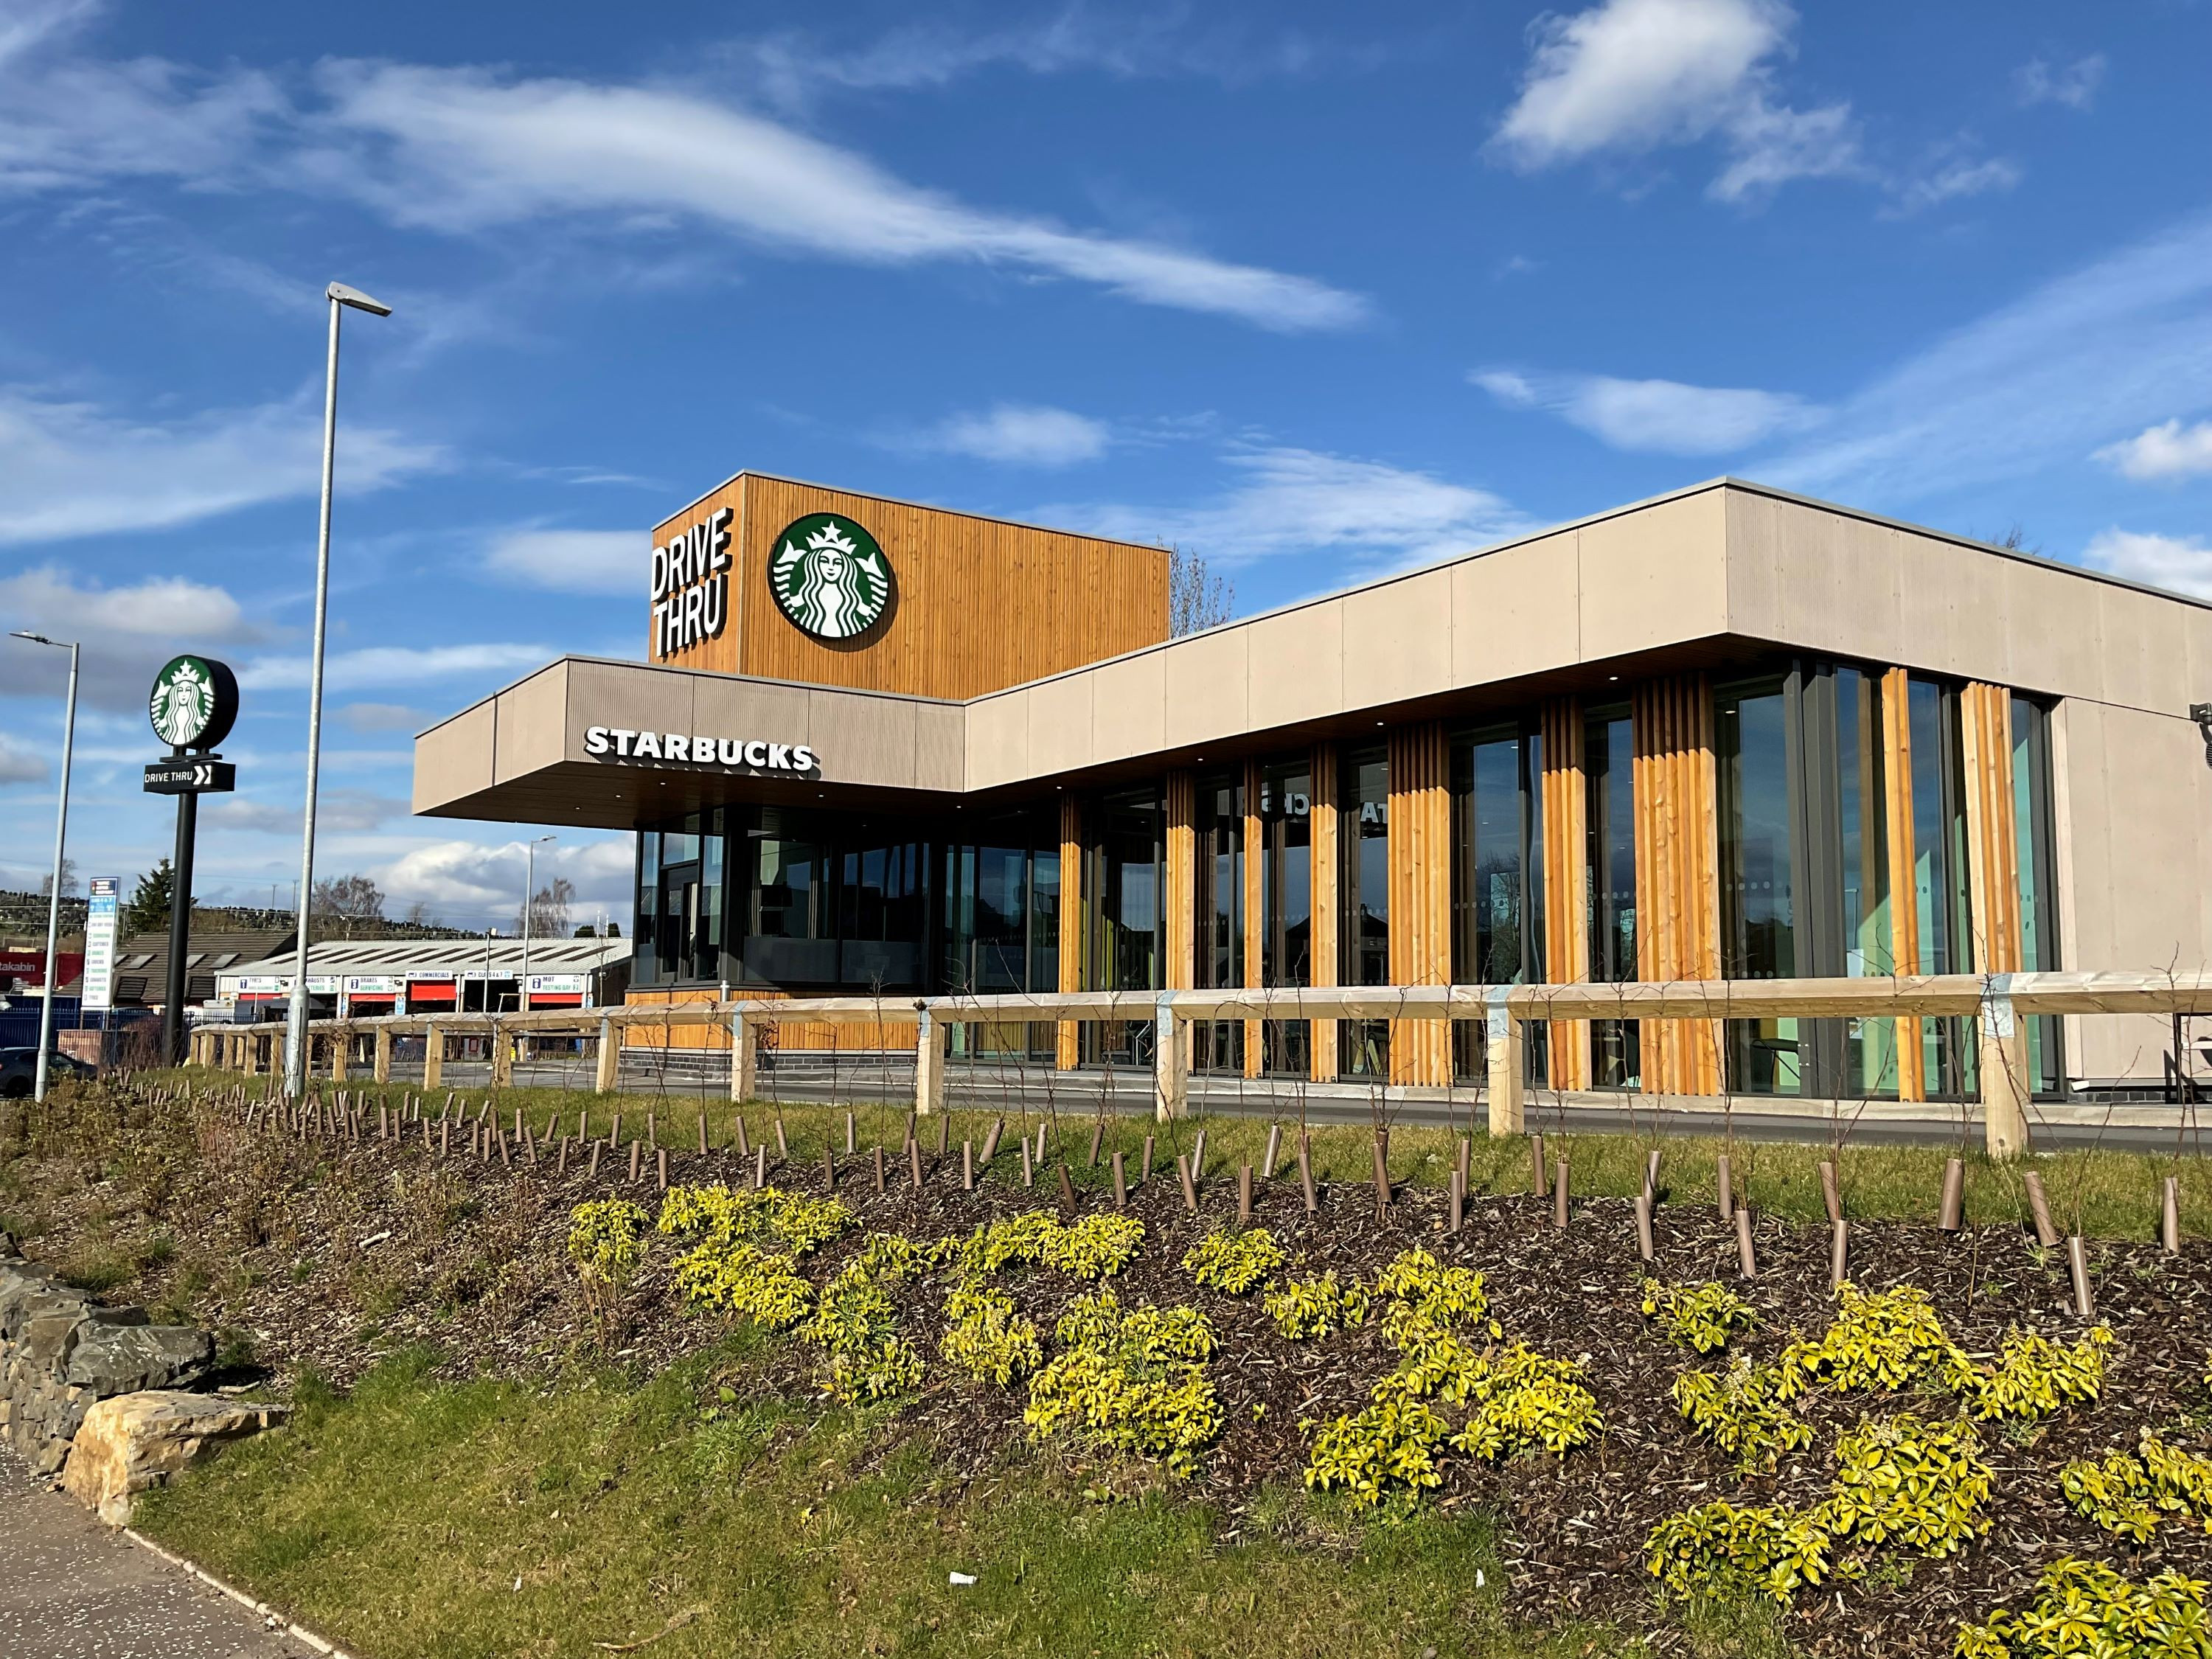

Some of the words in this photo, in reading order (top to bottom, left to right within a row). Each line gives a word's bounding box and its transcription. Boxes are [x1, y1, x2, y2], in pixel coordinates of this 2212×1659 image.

[650, 507, 732, 602] DRIVE
[653, 573, 726, 657] THRU
[145, 773, 168, 782] DRIVE
[171, 771, 192, 781] THRU
[585, 726, 813, 772] STARBUCKS
